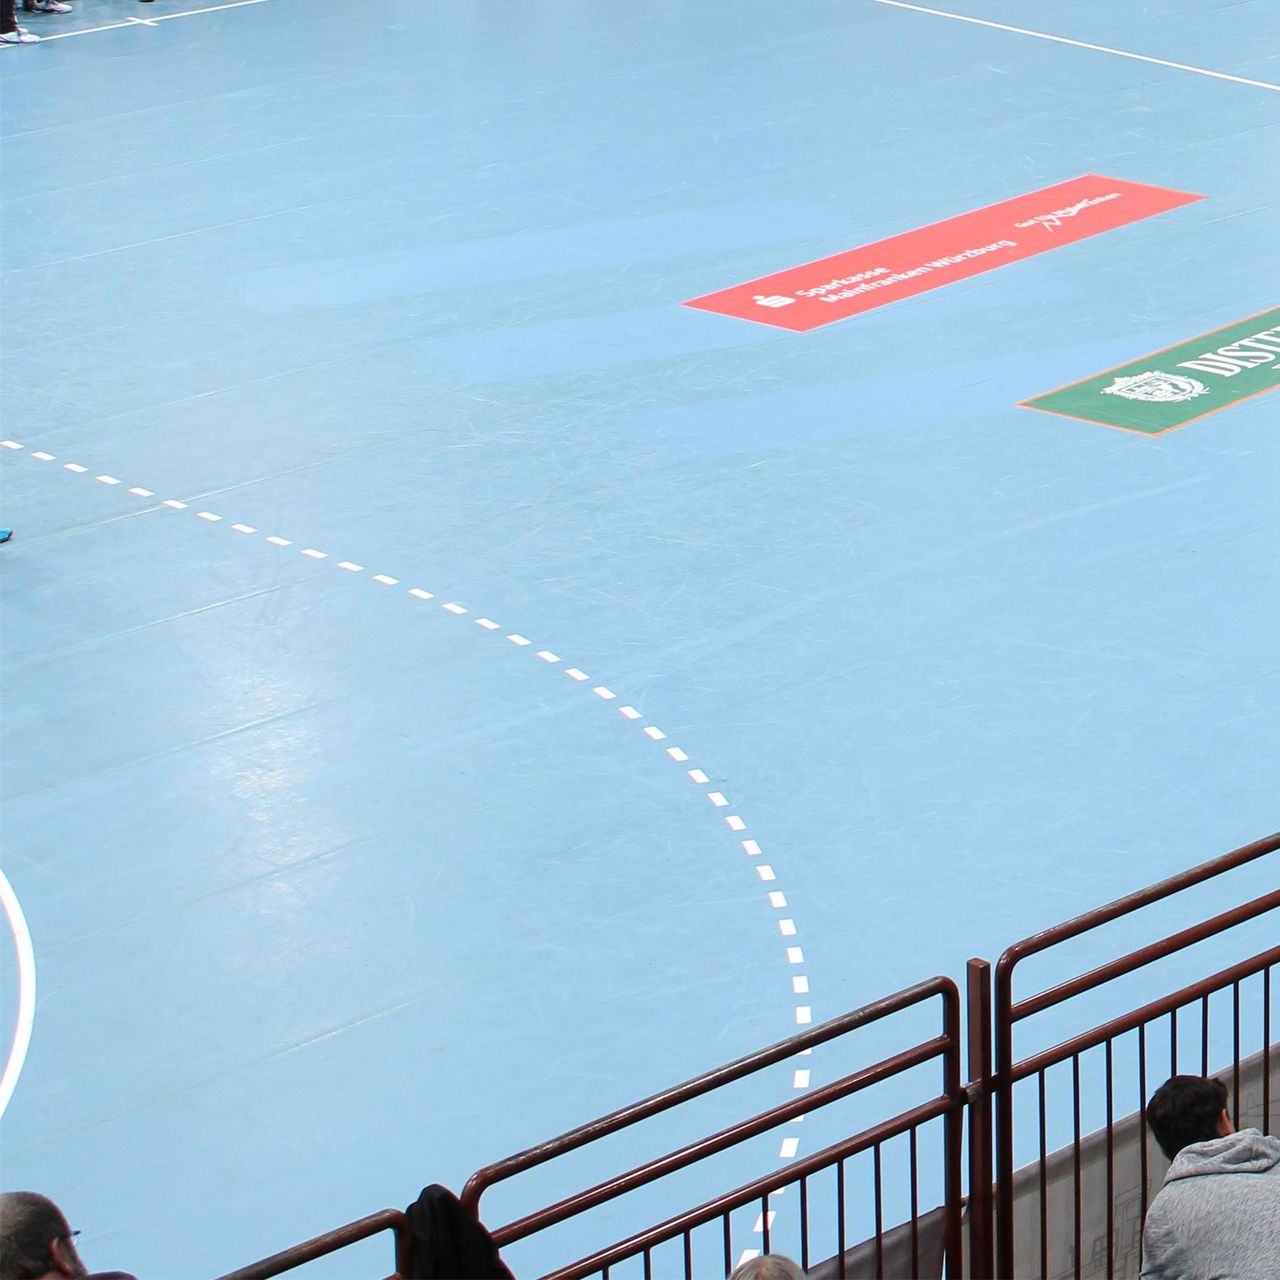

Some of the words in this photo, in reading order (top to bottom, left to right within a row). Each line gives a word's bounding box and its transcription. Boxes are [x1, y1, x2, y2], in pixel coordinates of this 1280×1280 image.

[795, 265, 890, 301] Sparkasse
[818, 264, 932, 305] Mainfranken
[929, 236, 1018, 270] Würzburg
